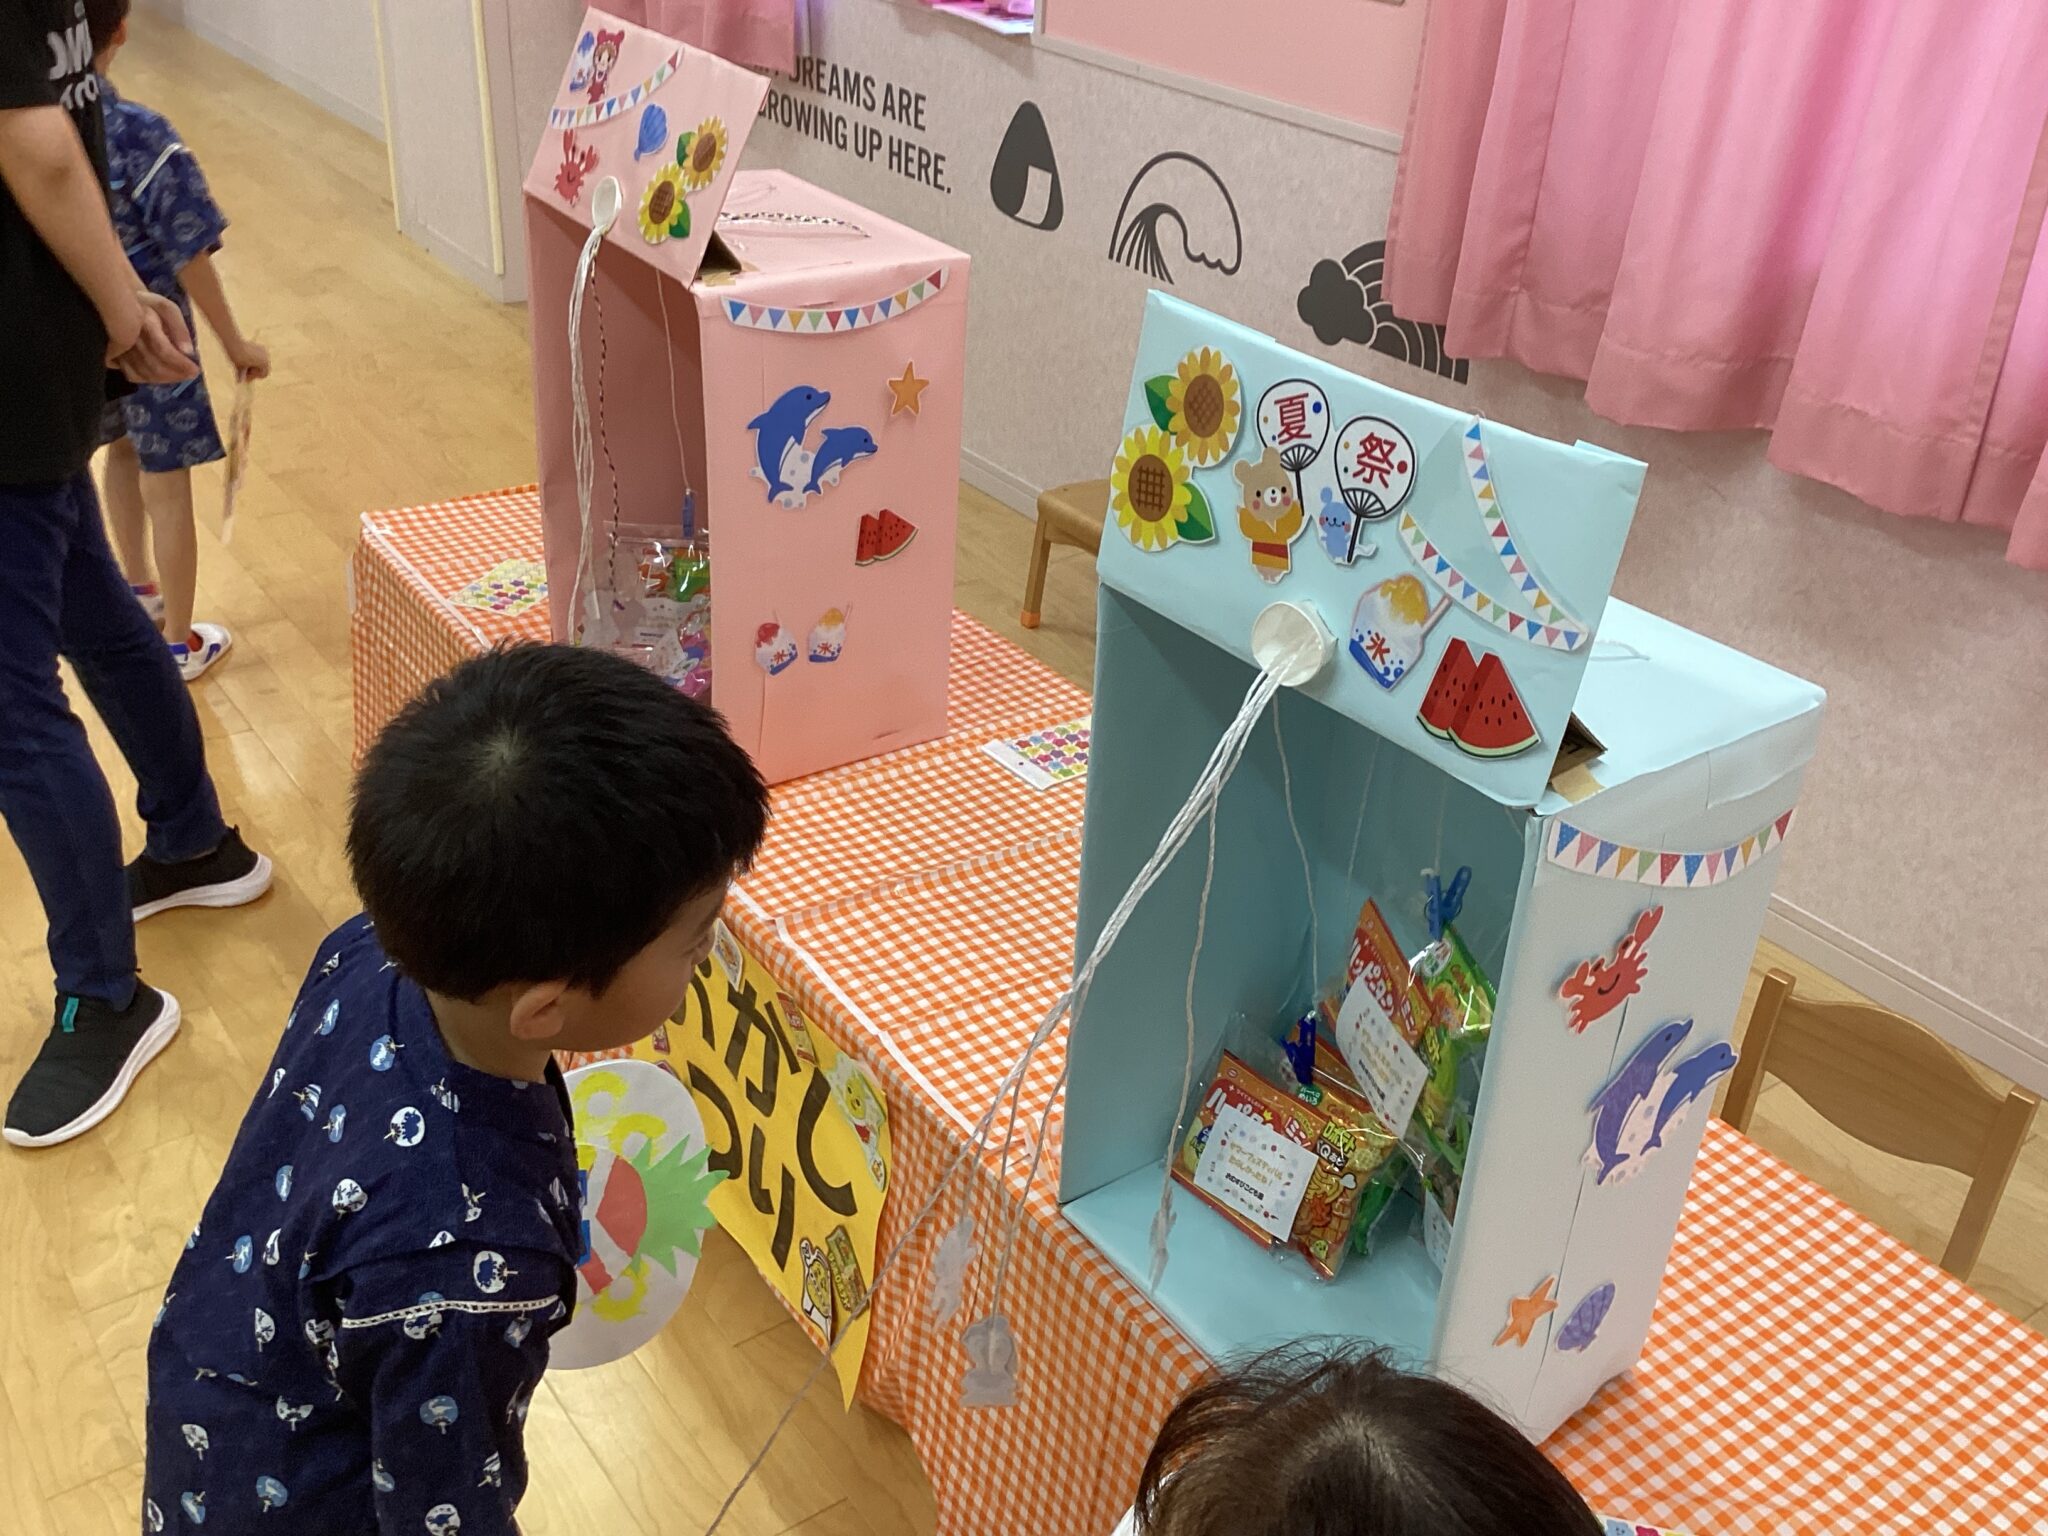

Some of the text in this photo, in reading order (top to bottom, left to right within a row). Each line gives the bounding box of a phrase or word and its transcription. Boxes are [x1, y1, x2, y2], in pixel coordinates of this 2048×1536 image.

[881, 82, 927, 132] ARE
[853, 121, 883, 163] UP
[888, 134, 952, 194] HERE.
[1274, 392, 1312, 446] 夏
[1352, 431, 1398, 489] 祭
